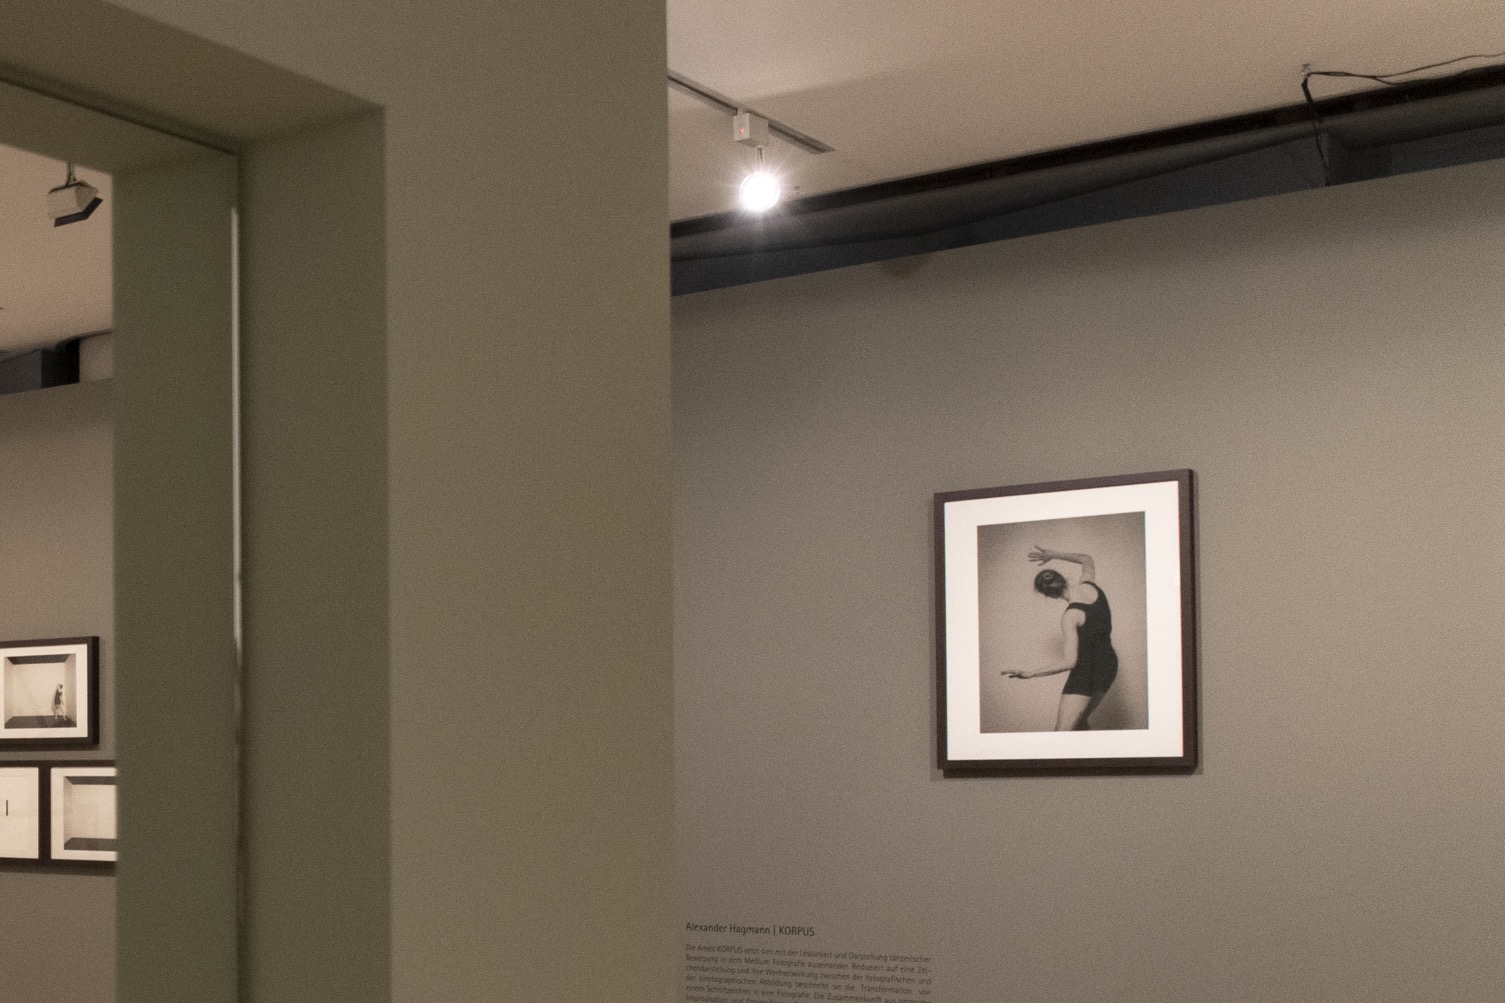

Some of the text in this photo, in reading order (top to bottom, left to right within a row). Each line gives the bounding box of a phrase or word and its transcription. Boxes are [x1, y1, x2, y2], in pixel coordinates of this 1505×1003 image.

[686, 922, 727, 932] Alexander
[729, 924, 770, 936] Hagmann
[779, 926, 815, 936] KORPUS
